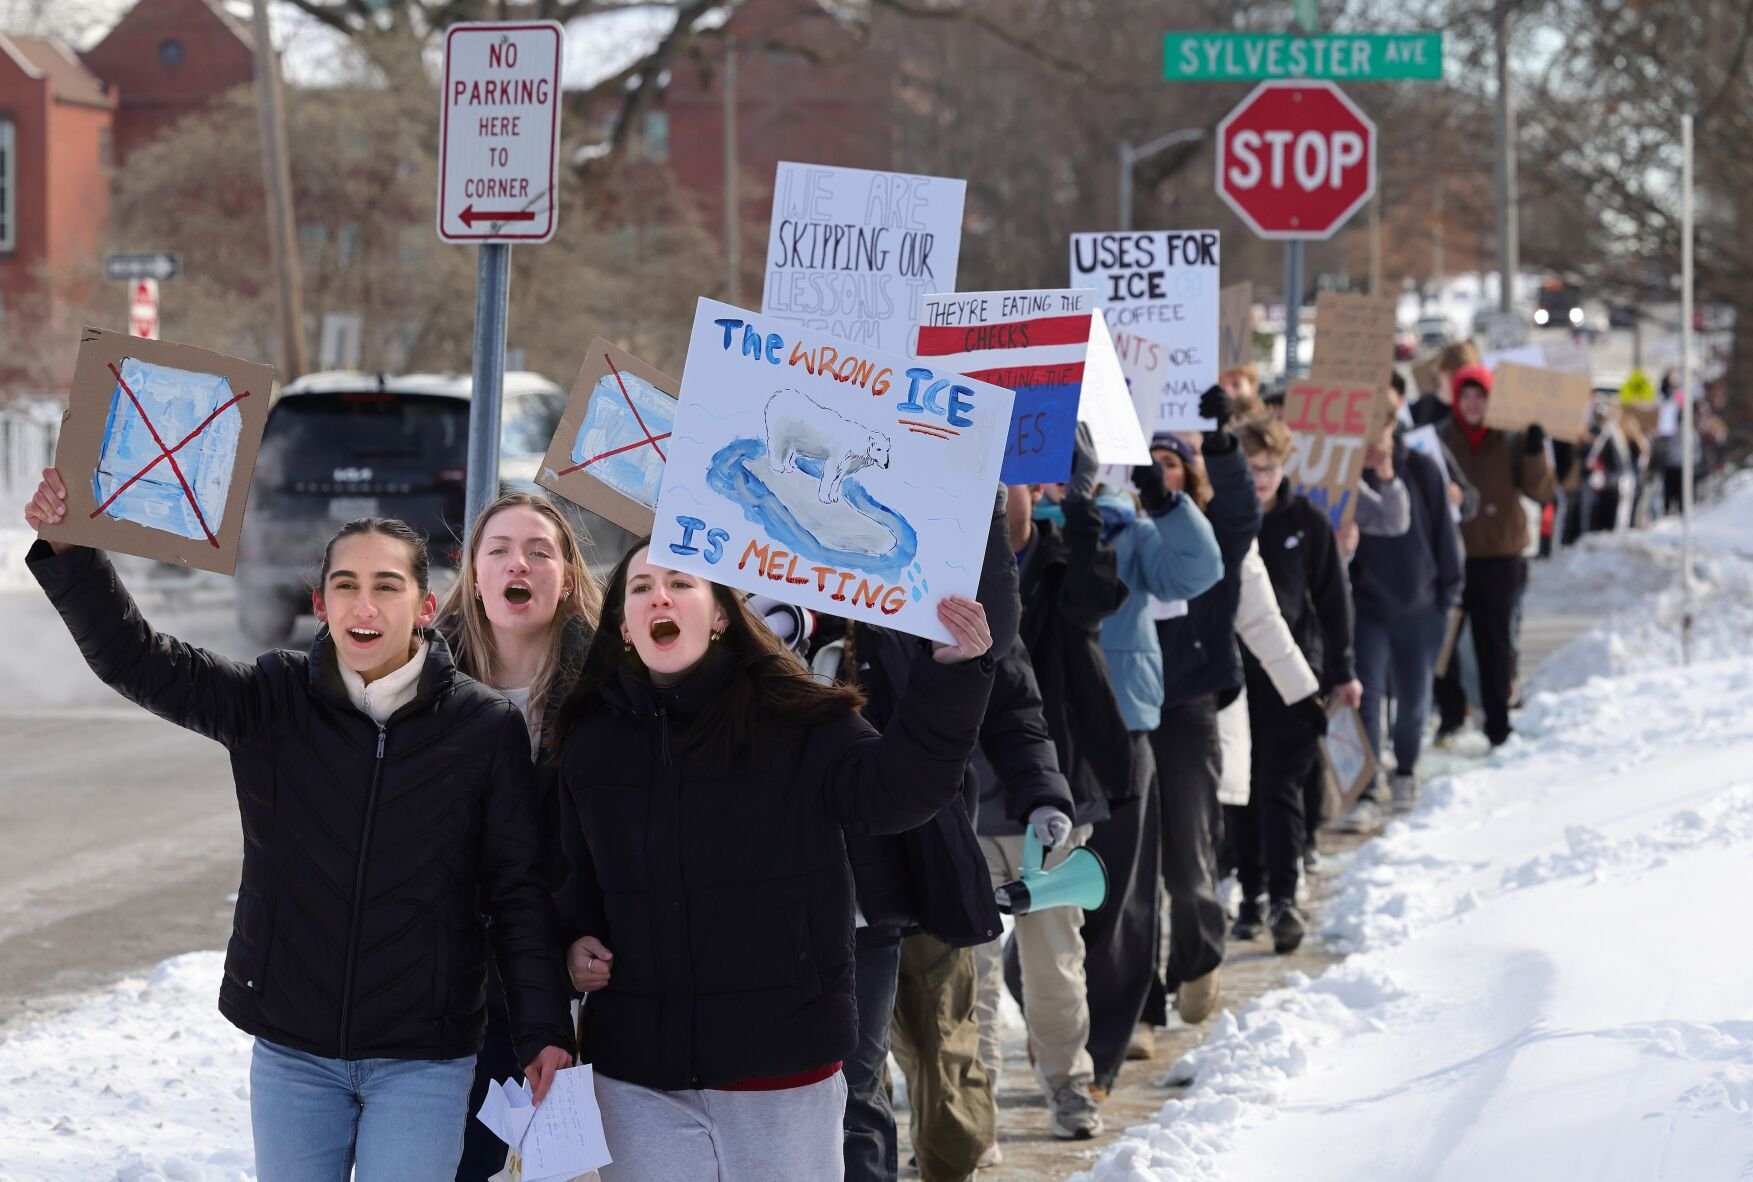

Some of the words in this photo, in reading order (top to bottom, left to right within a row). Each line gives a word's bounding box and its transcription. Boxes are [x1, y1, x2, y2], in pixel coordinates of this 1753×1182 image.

[489, 42, 518, 68] NO
[1179, 37, 1372, 75] SYLVESTER
[1384, 38, 1427, 64] AVE
[454, 78, 548, 106] PARKING
[478, 116, 520, 137] HERE
[489, 147, 508, 167] TO
[1228, 129, 1364, 192] STOP
[465, 178, 529, 199] CORNER
[781, 168, 835, 222] WE
[863, 173, 931, 231] ARE
[774, 219, 890, 272] SKIPPING
[899, 231, 935, 280] OUR
[1075, 235, 1155, 274] USES
[1166, 234, 1219, 267] FOR
[767, 271, 895, 320] LESSONS
[1108, 271, 1166, 301] ICE
[926, 298, 988, 328] THEY'RE
[1001, 294, 1052, 317] EATING
[1060, 294, 1083, 312] THE
[1103, 303, 1186, 328] COFFEE
[964, 323, 1030, 353] CHECKS
[714, 318, 785, 365] The
[788, 341, 894, 396] WRONG
[896, 367, 976, 427] ICE
[1046, 367, 1073, 390] THE
[1288, 387, 1372, 435] ICE
[1004, 411, 1048, 457] ES
[669, 515, 730, 564] IS
[738, 539, 907, 614] MELTING
